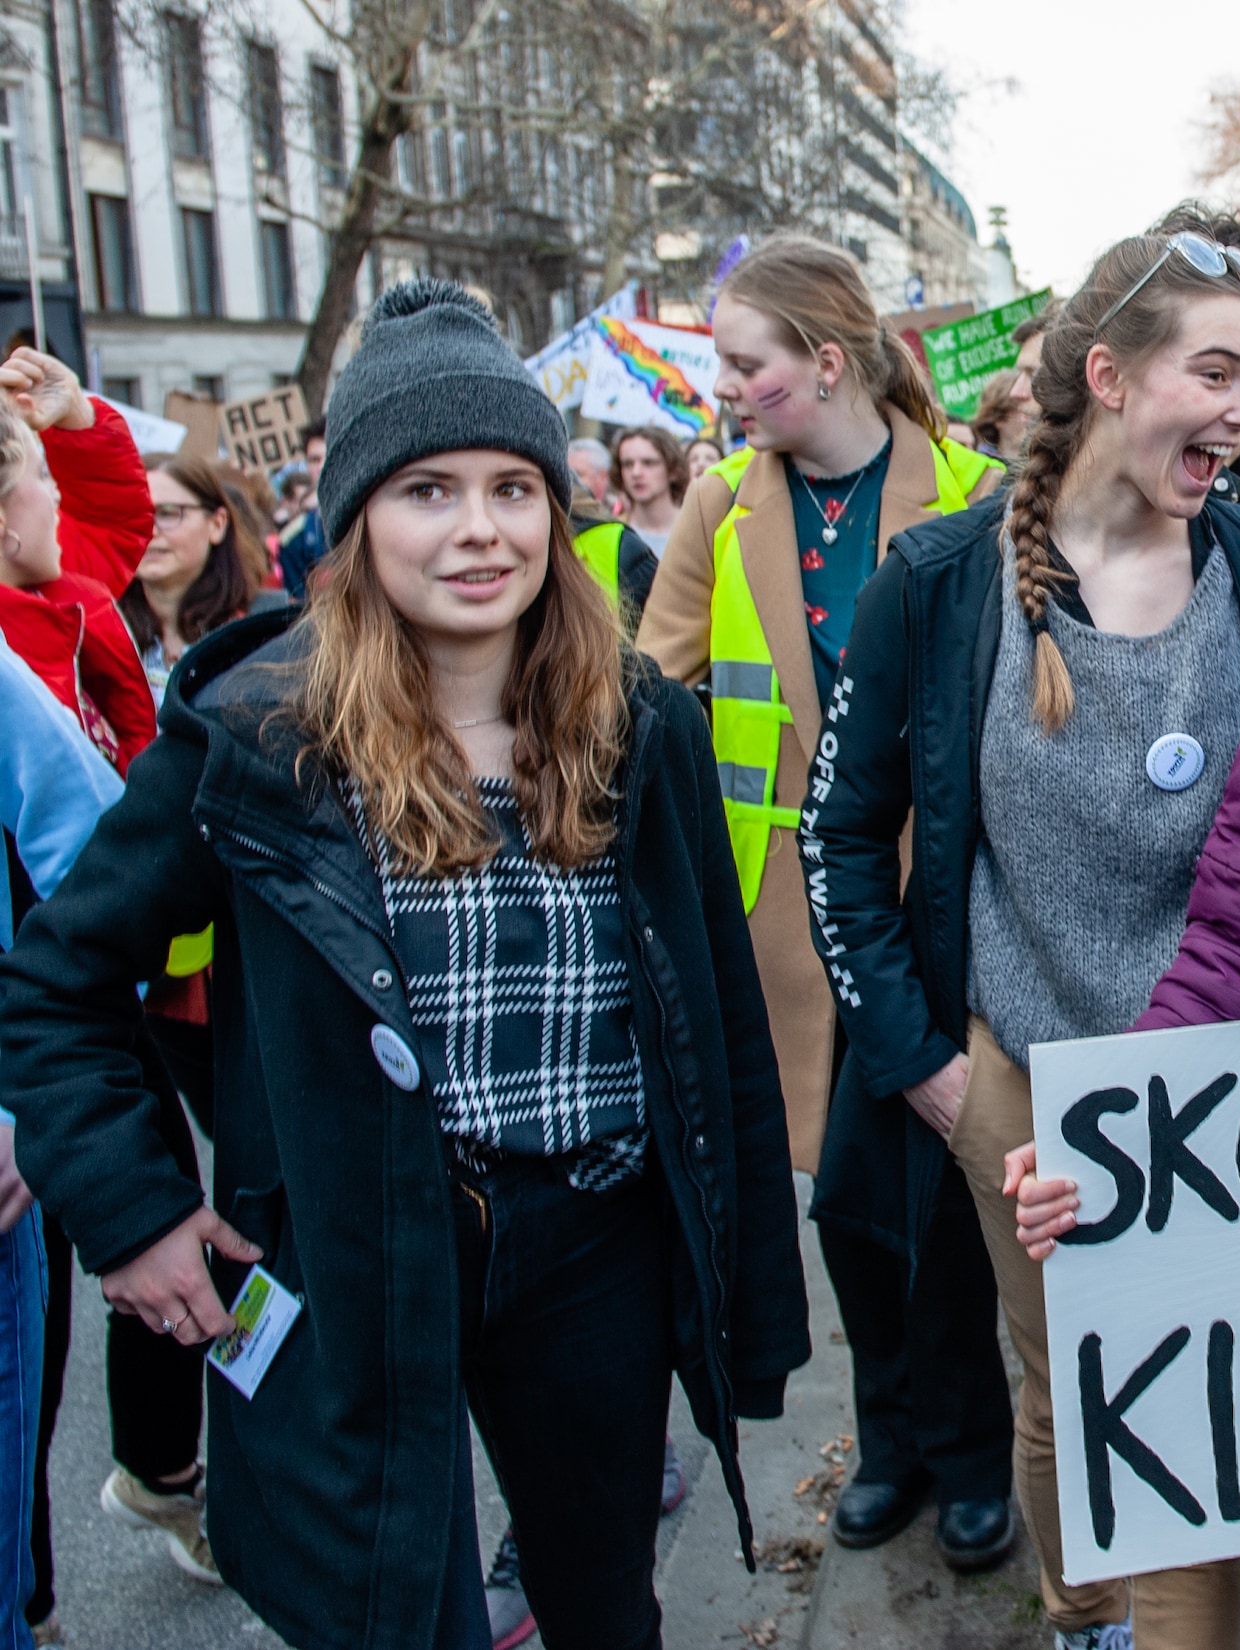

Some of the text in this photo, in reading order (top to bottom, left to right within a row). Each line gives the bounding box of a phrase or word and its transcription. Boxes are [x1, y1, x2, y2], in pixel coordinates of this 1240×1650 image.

[922, 329, 957, 354] WE
[958, 312, 998, 347] HAVE
[935, 356, 957, 381] OF
[225, 392, 293, 436] ACT
[234, 429, 301, 470] NOW
[799, 730, 848, 957] OFF THE WALL
